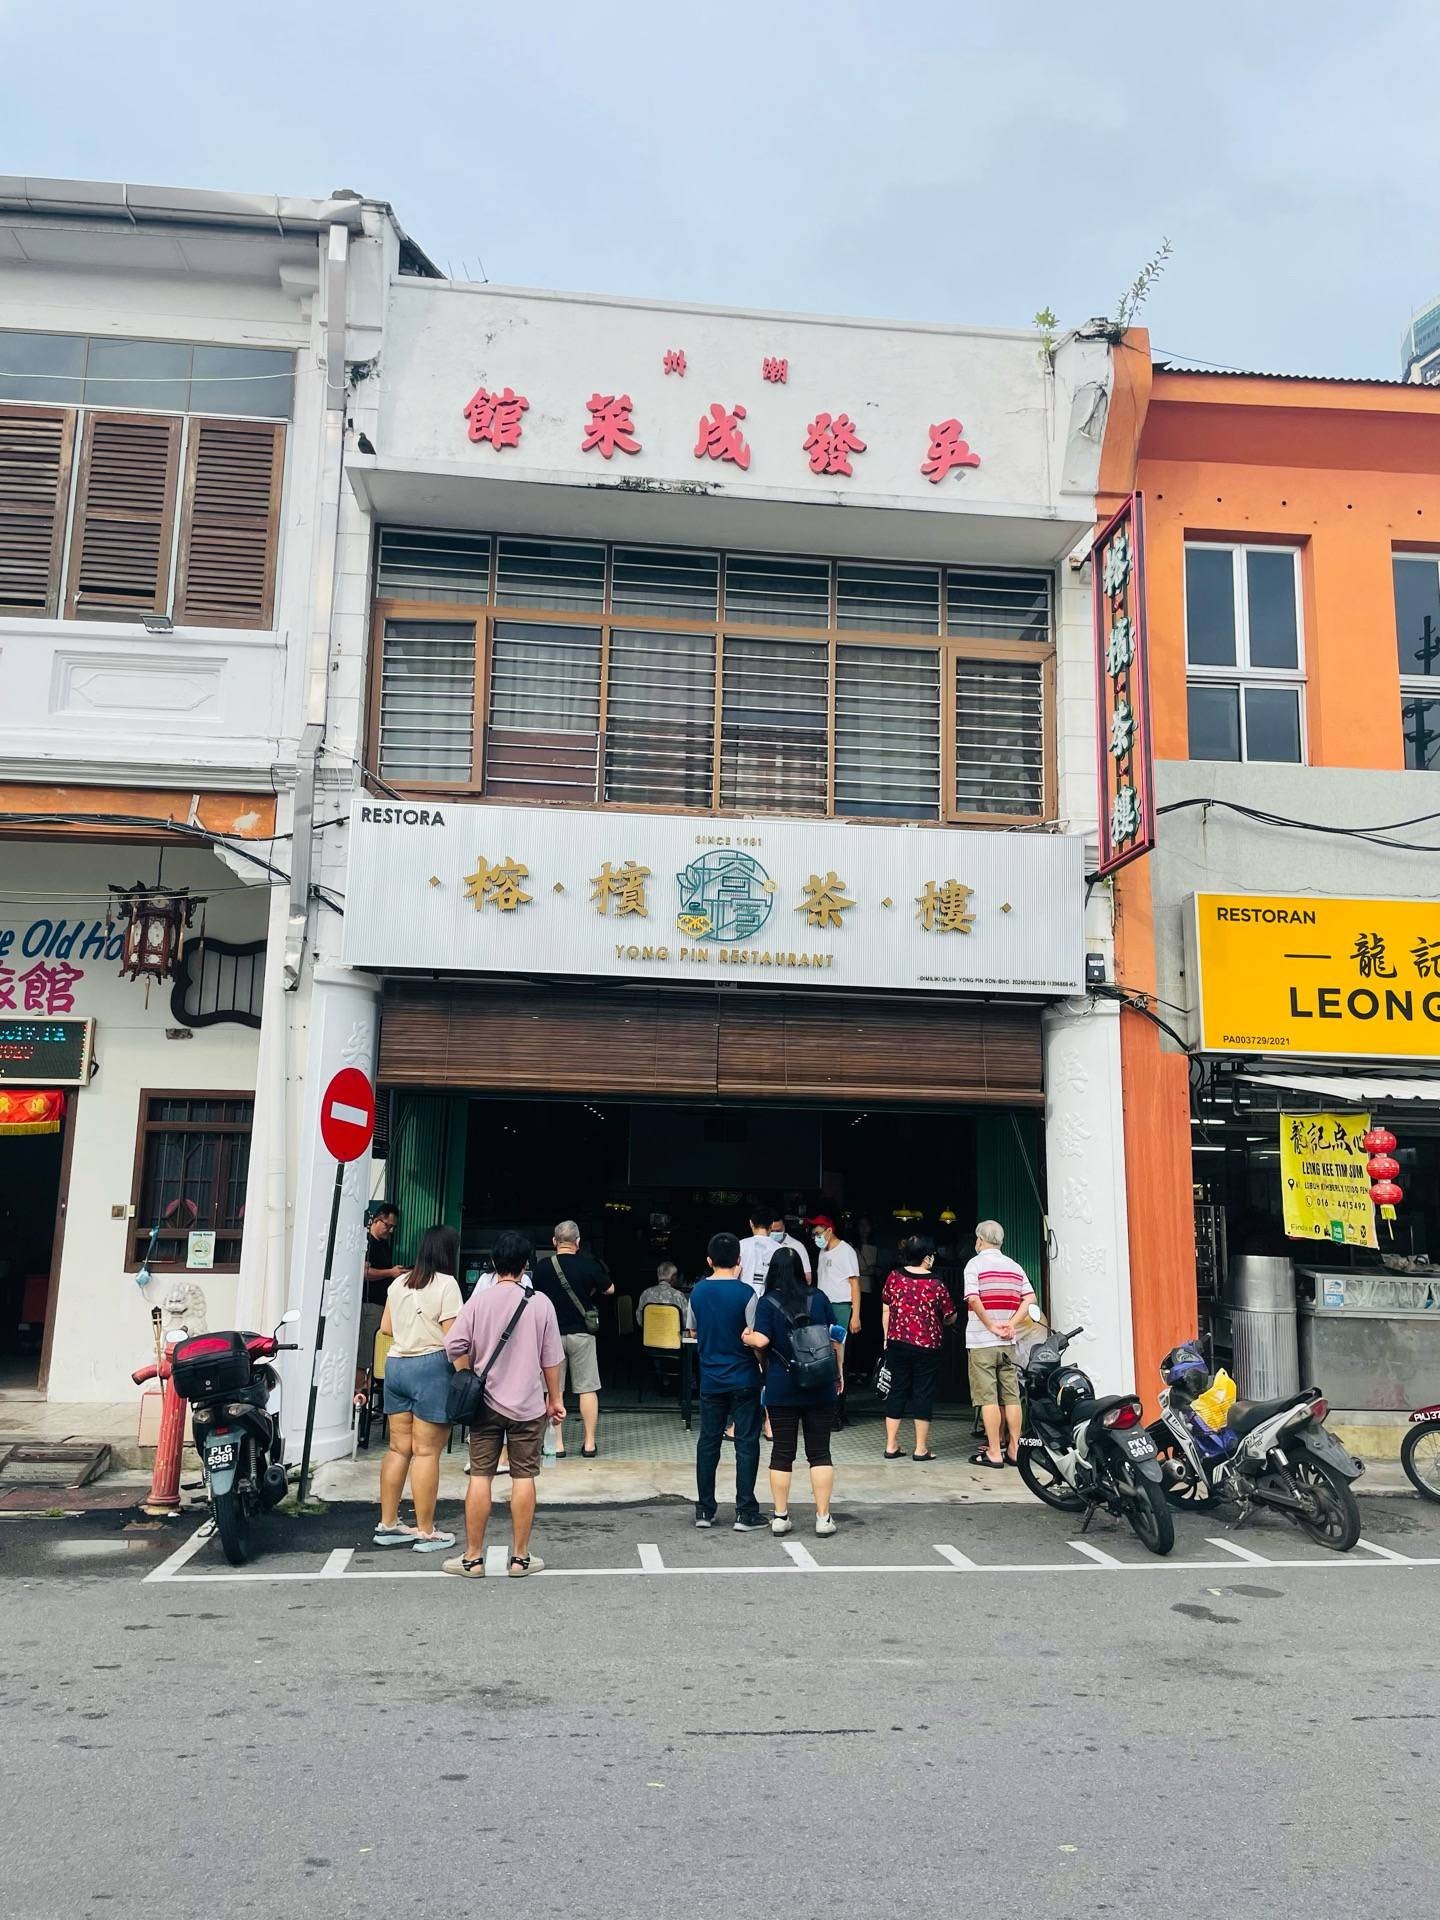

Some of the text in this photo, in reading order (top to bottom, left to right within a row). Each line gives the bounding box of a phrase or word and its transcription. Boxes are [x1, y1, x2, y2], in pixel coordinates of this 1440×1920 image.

[361, 807, 445, 826] RESTORA
[695, 835, 731, 846] SINCE
[1217, 907, 1316, 924] RESTORAN
[22, 919, 85, 958] Old
[615, 944, 834, 968] YONG PIN RESTAURANT
[1290, 986, 1440, 1023] LEONG
[1223, 1035, 1290, 1046] PA003729/2021
[1302, 1161, 1320, 1176] LEONG
[1321, 1163, 1333, 1177] KEE
[1334, 1163, 1347, 1178] TIM
[1316, 1198, 1329, 1207] 016
[1337, 1200, 1366, 1211] 4415492
[1128, 1437, 1147, 1450] PKV
[208, 1452, 233, 1465] 5981
